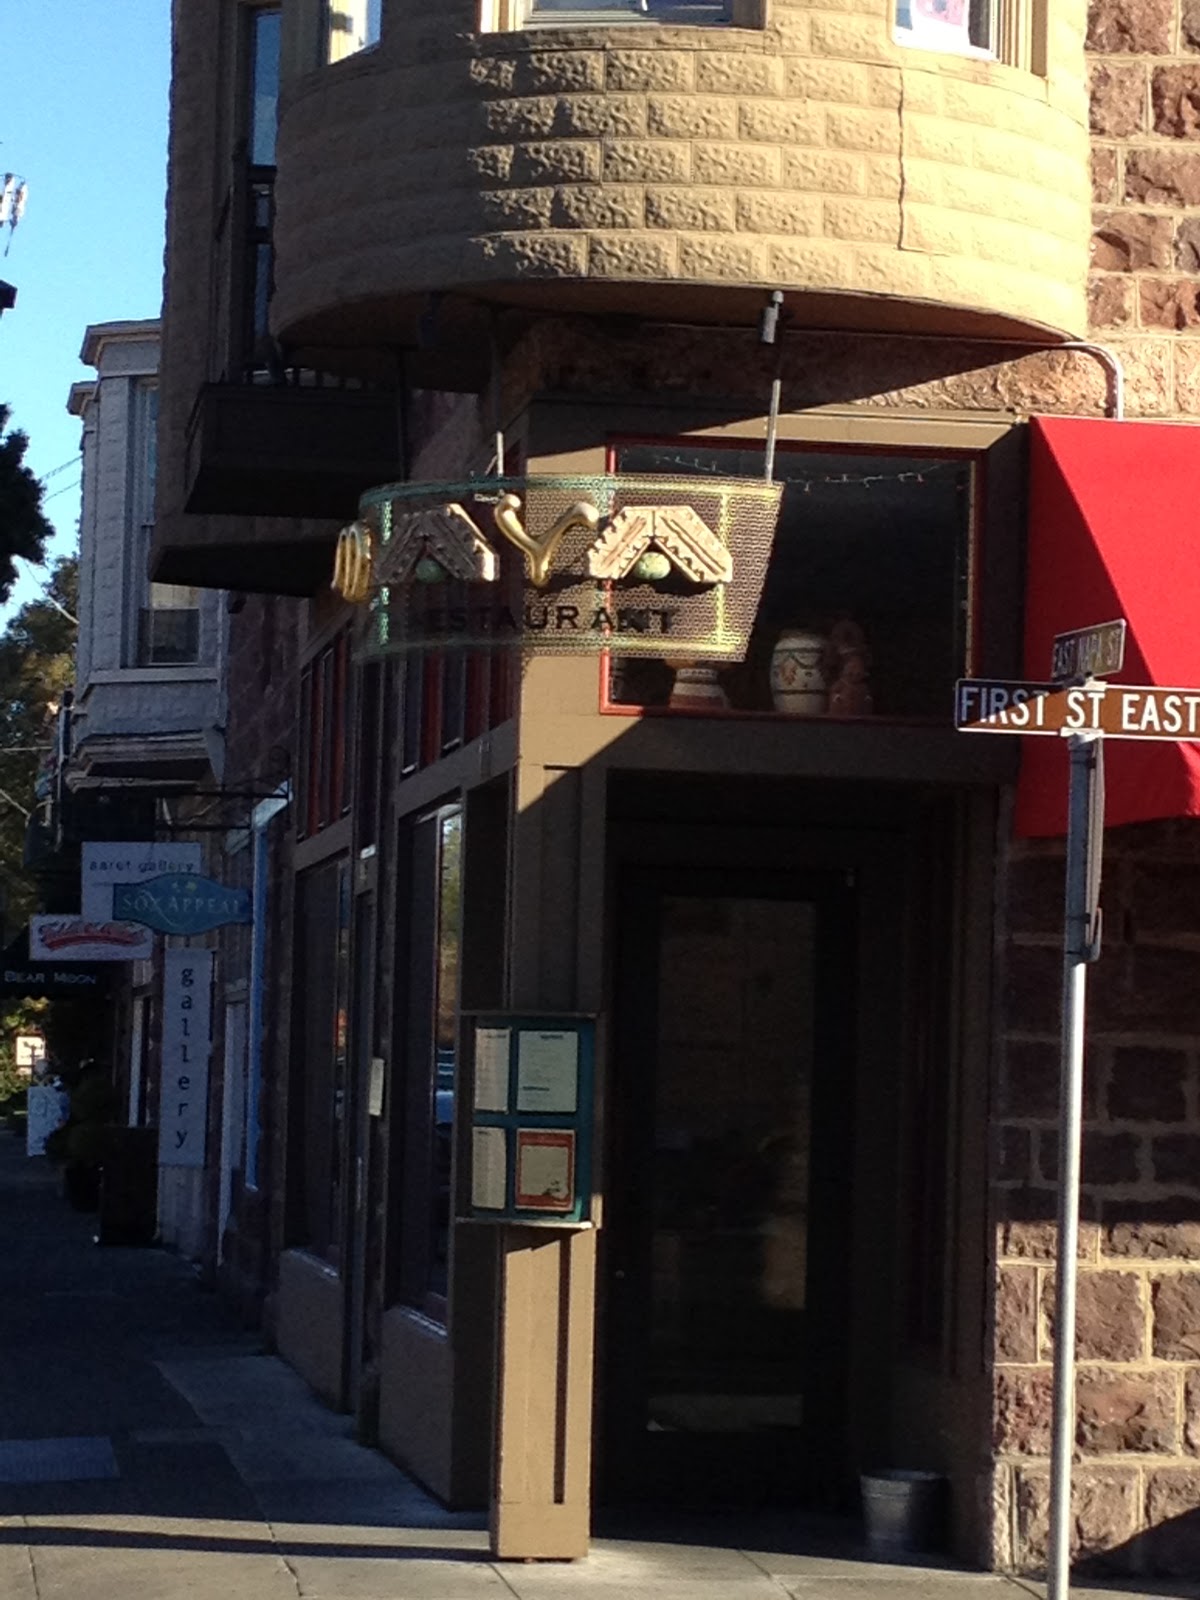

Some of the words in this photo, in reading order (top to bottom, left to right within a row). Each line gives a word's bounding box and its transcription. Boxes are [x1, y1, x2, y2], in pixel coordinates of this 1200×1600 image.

[960, 685, 1050, 726] FIRST
[1066, 690, 1106, 729] ST
[1121, 693, 1200, 733] EAST
[168, 896, 240, 914] APPEAL
[4, 969, 45, 984] BEAR
[54, 971, 96, 985] MOON
[174, 966, 195, 1149] gallery
